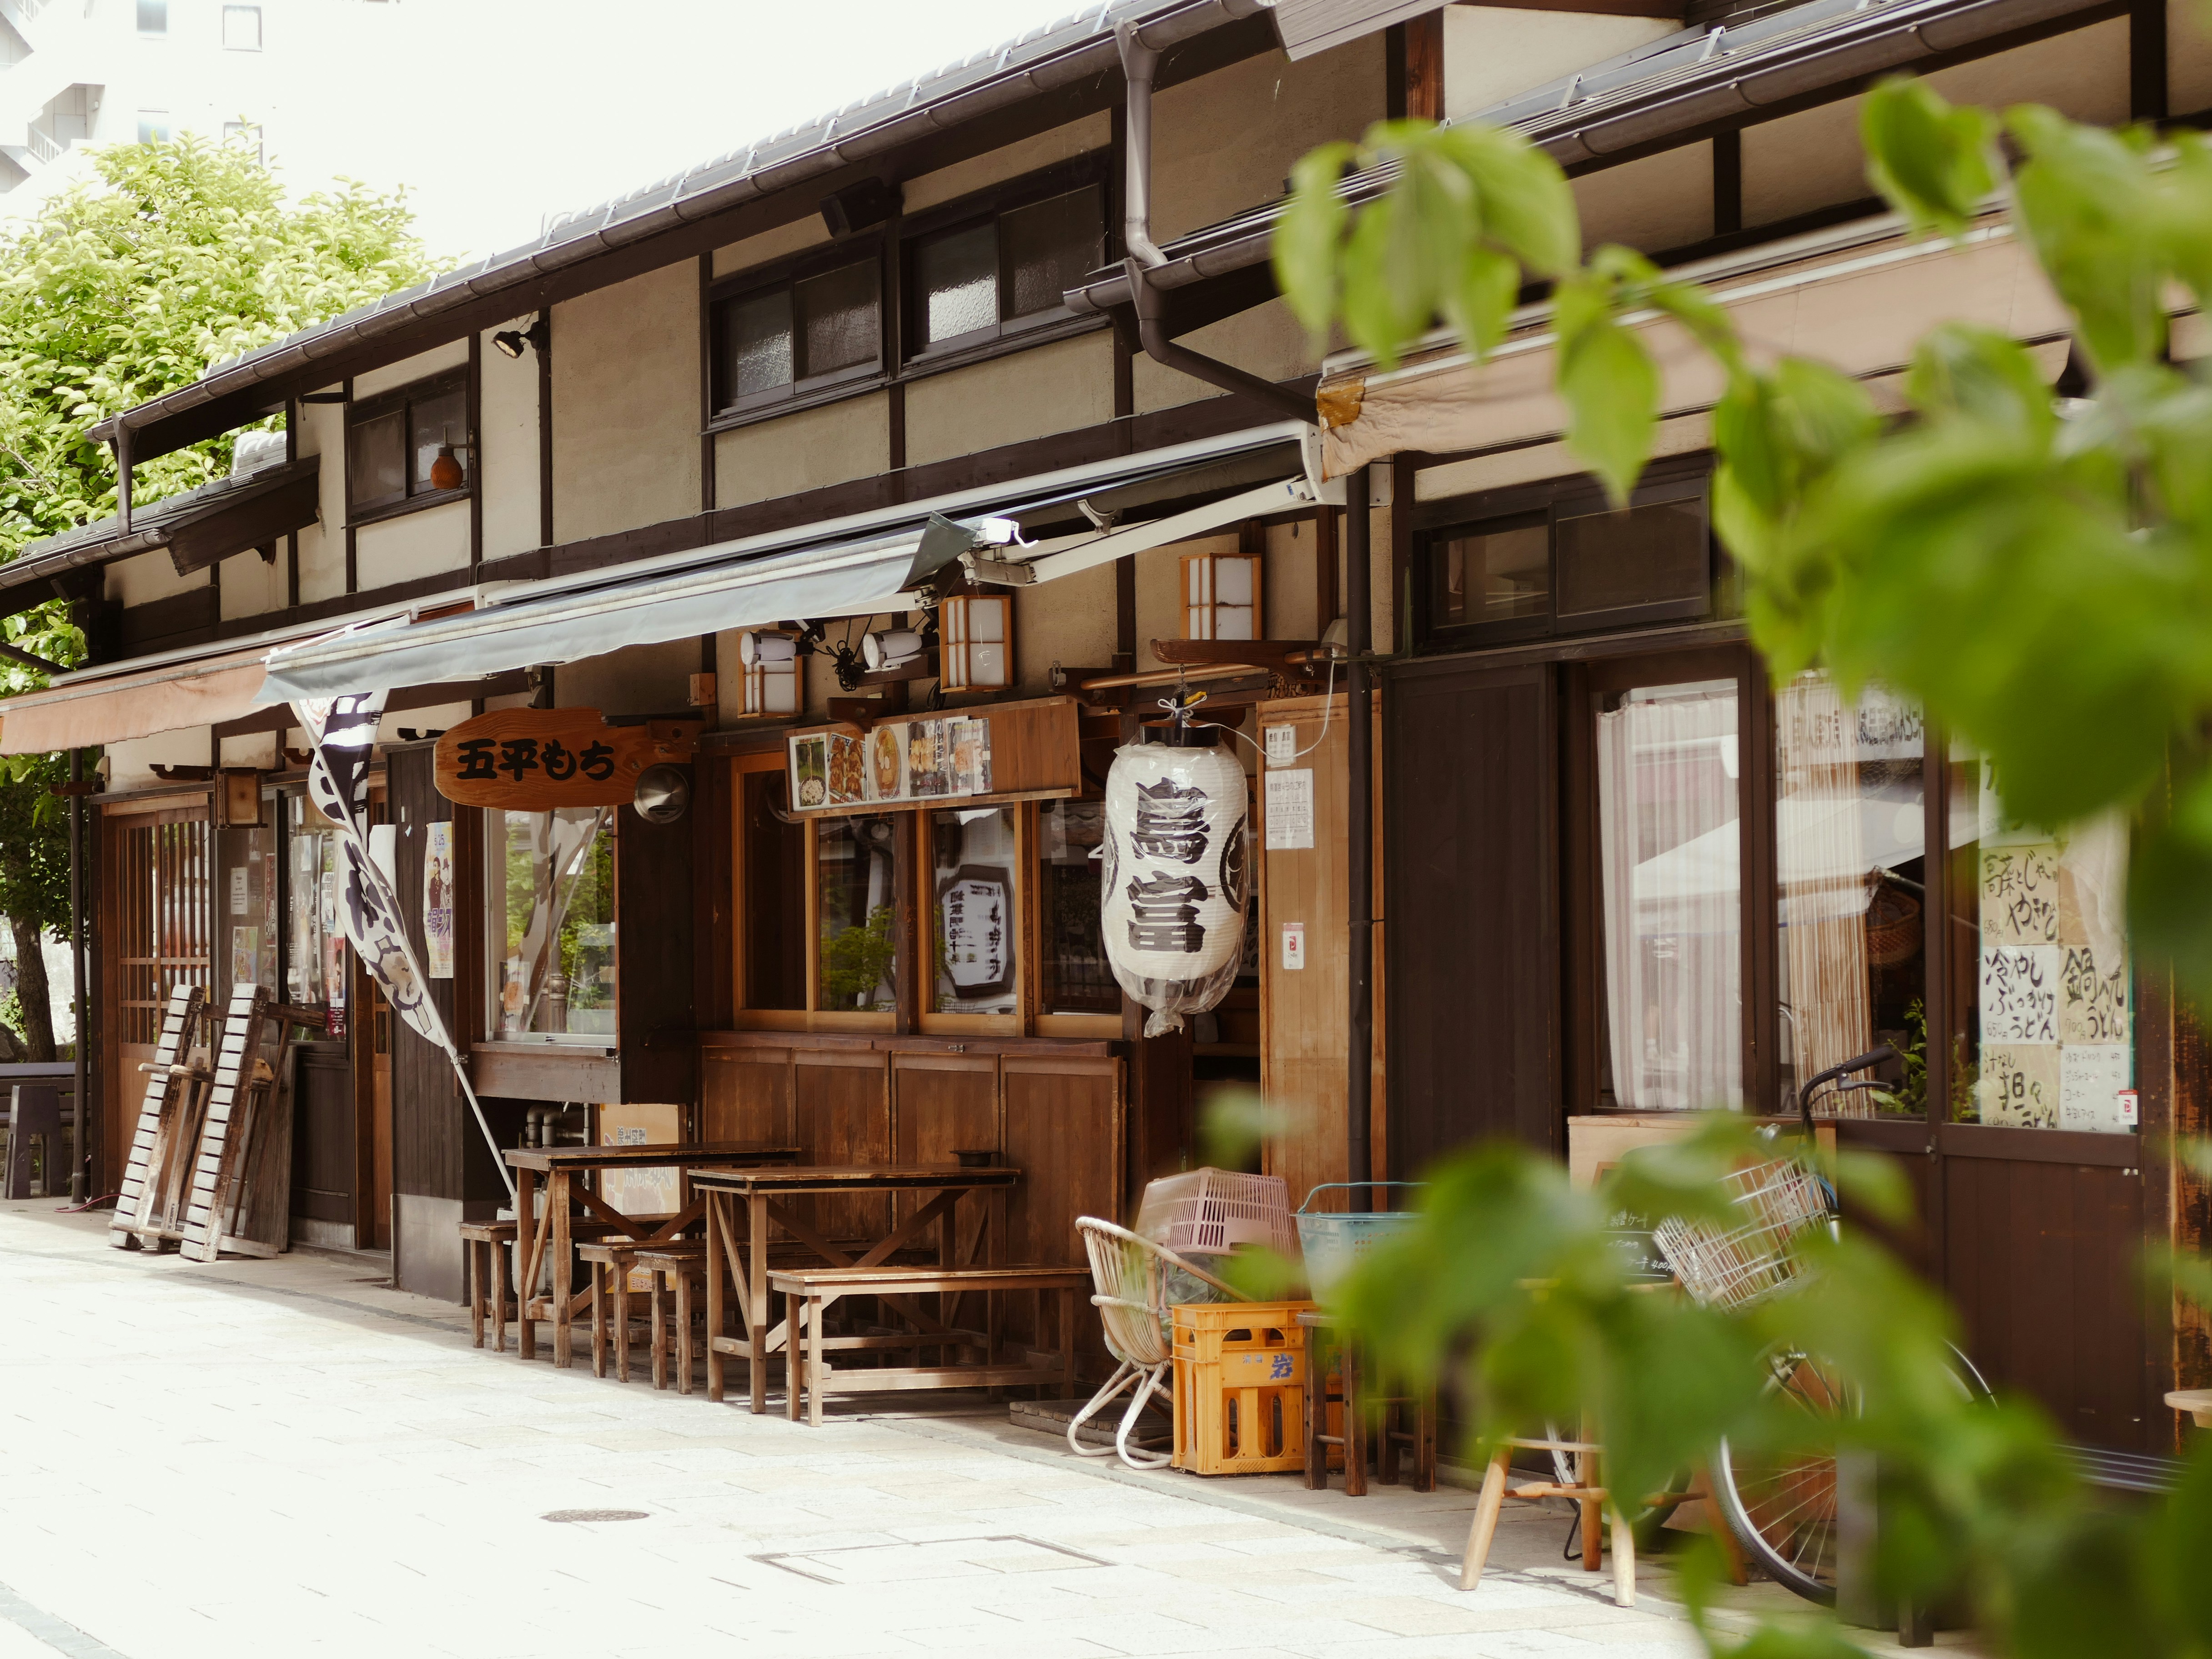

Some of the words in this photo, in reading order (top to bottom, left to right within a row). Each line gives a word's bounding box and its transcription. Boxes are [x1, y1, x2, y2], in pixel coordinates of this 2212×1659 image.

[457, 738, 614, 781] 五平もち
[1985, 949, 2043, 988] 冷やし
[1989, 984, 2055, 1016] ぶっかけ
[1986, 1021, 2008, 1040] 650円
[2010, 1011, 2055, 1041] うどん
[2065, 1018, 2086, 1041] 700円
[2086, 1004, 2124, 1041] うどん
[1985, 1049, 2016, 1074] 汁なし
[1998, 1071, 2042, 1111] 担々
